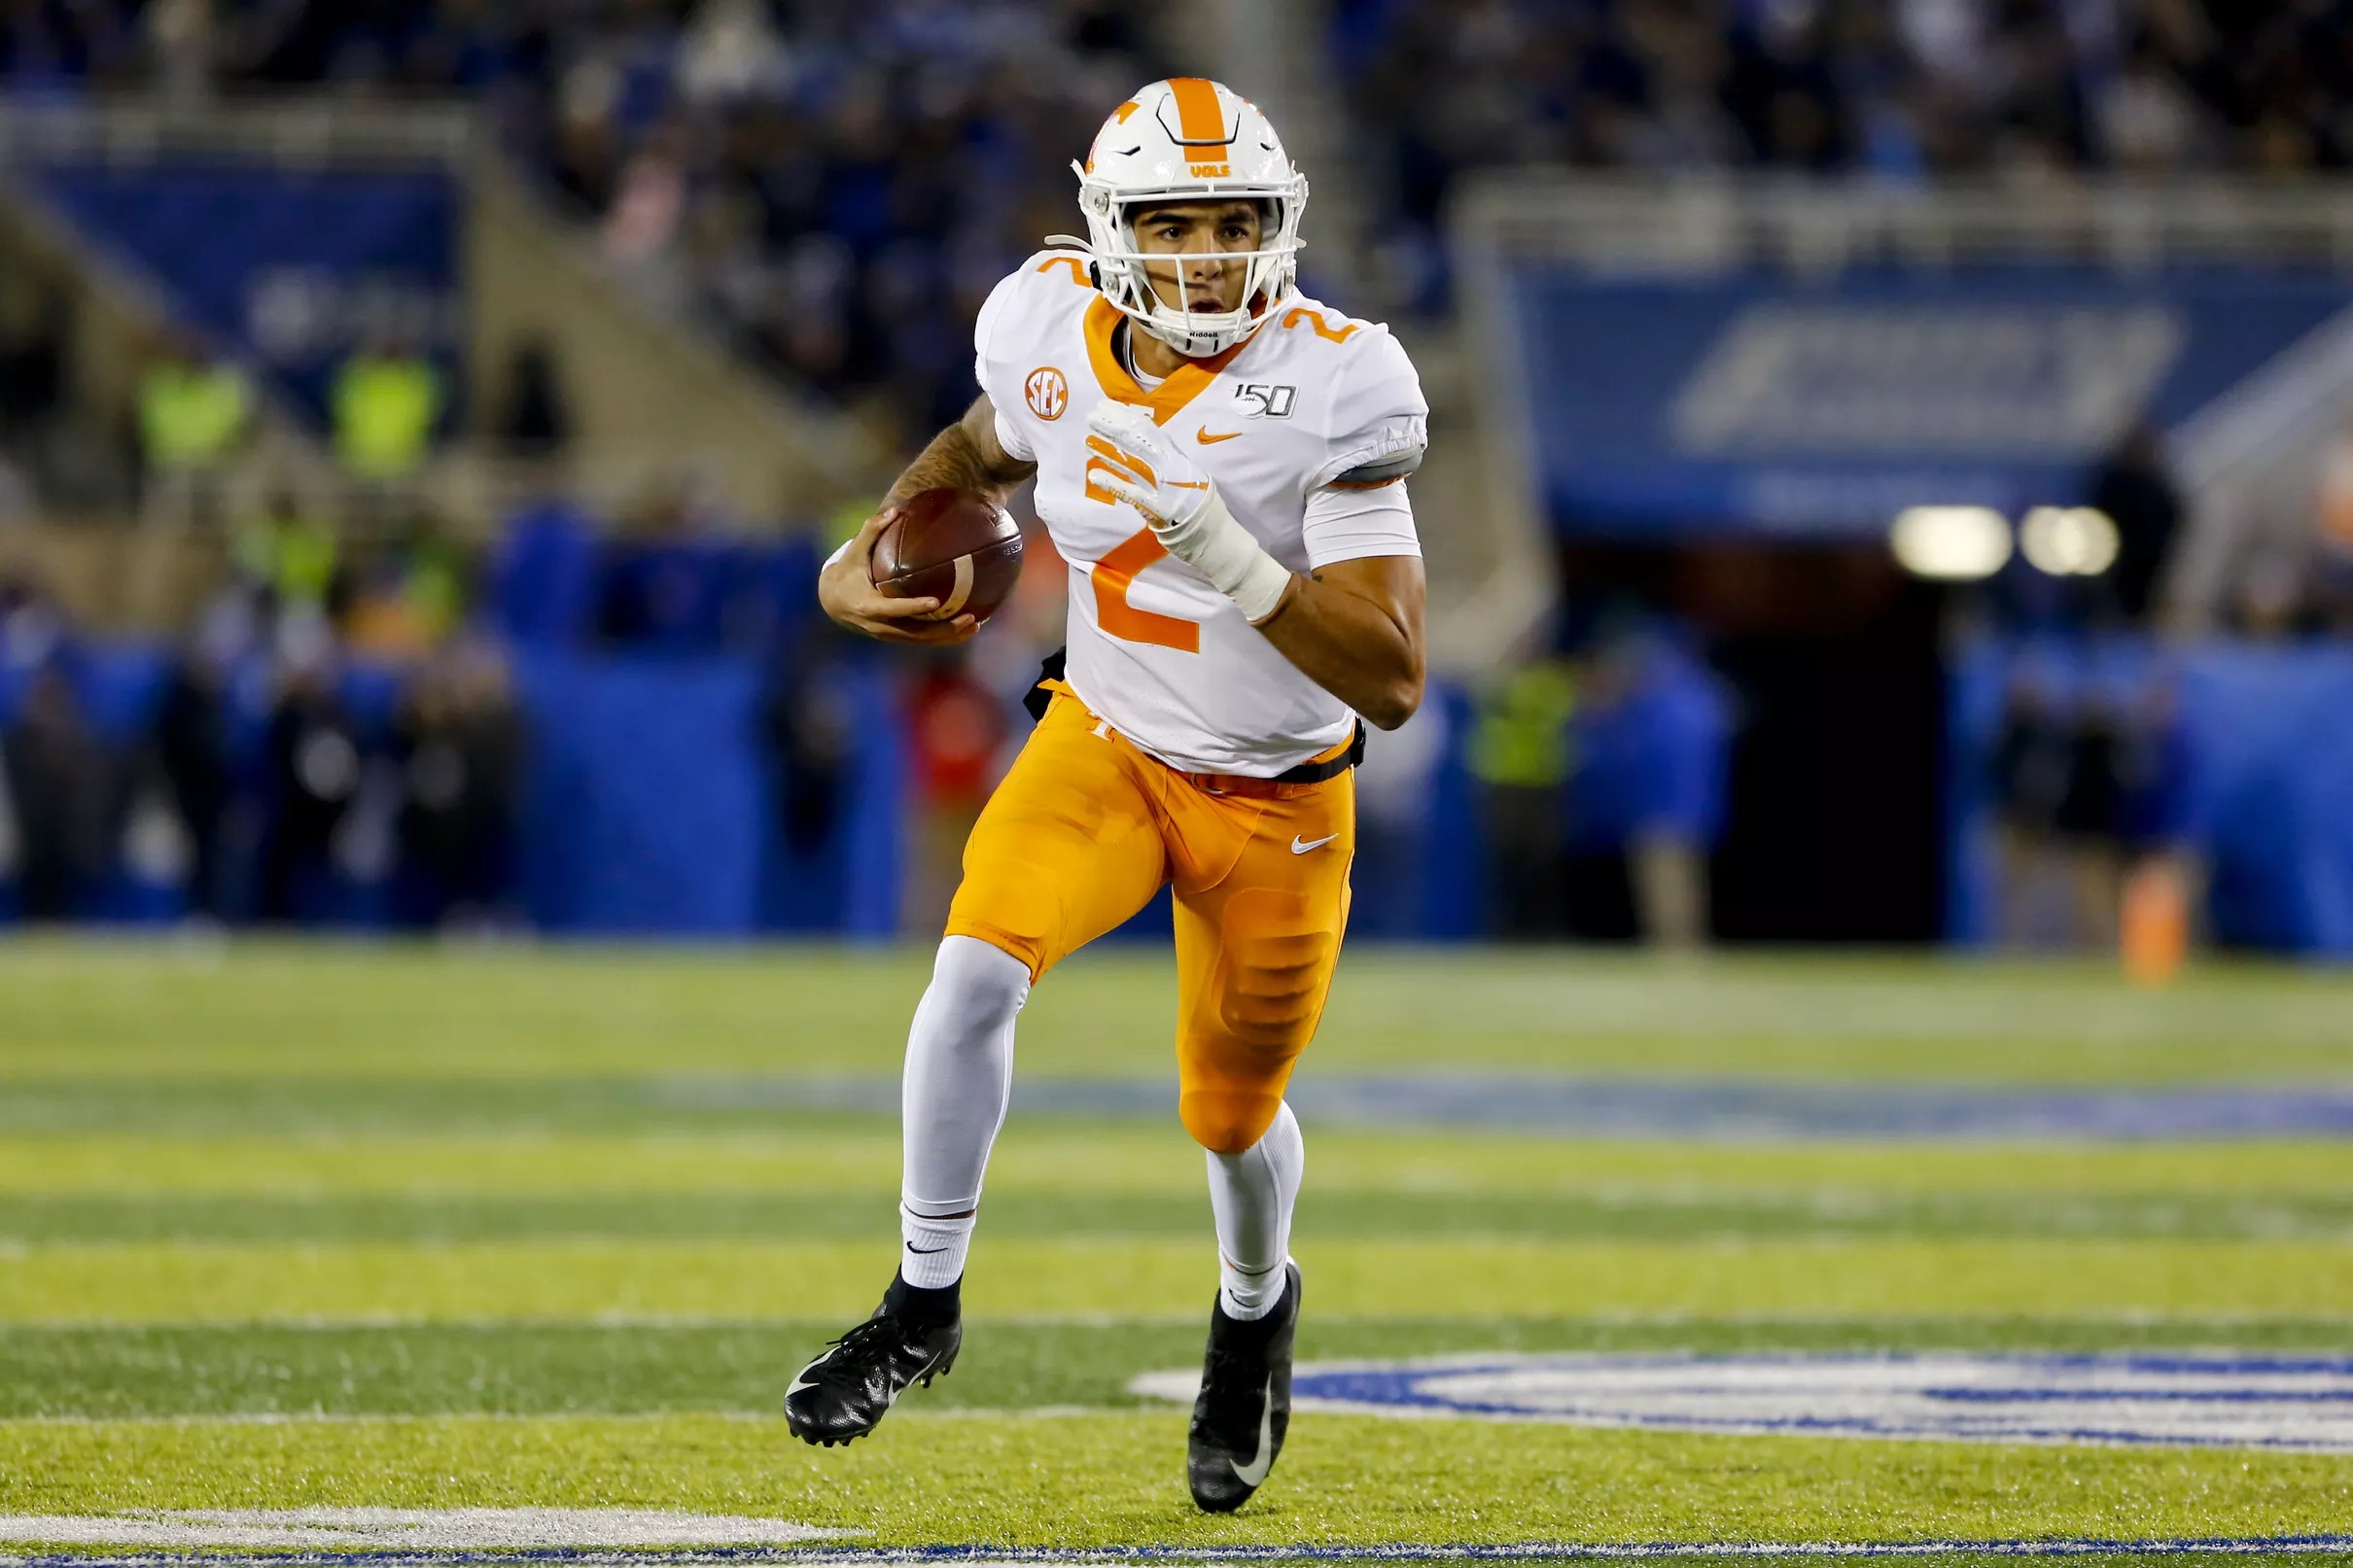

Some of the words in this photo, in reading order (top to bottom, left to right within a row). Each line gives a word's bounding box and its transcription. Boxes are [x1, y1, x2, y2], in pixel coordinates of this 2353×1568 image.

[1190, 164, 1230, 178] VOLS
[1036, 257, 1093, 288] 2
[1282, 307, 1360, 344] 2
[1026, 368, 1067, 418] SEC
[1233, 383, 1297, 417] 150
[1084, 455, 1200, 654] 2
